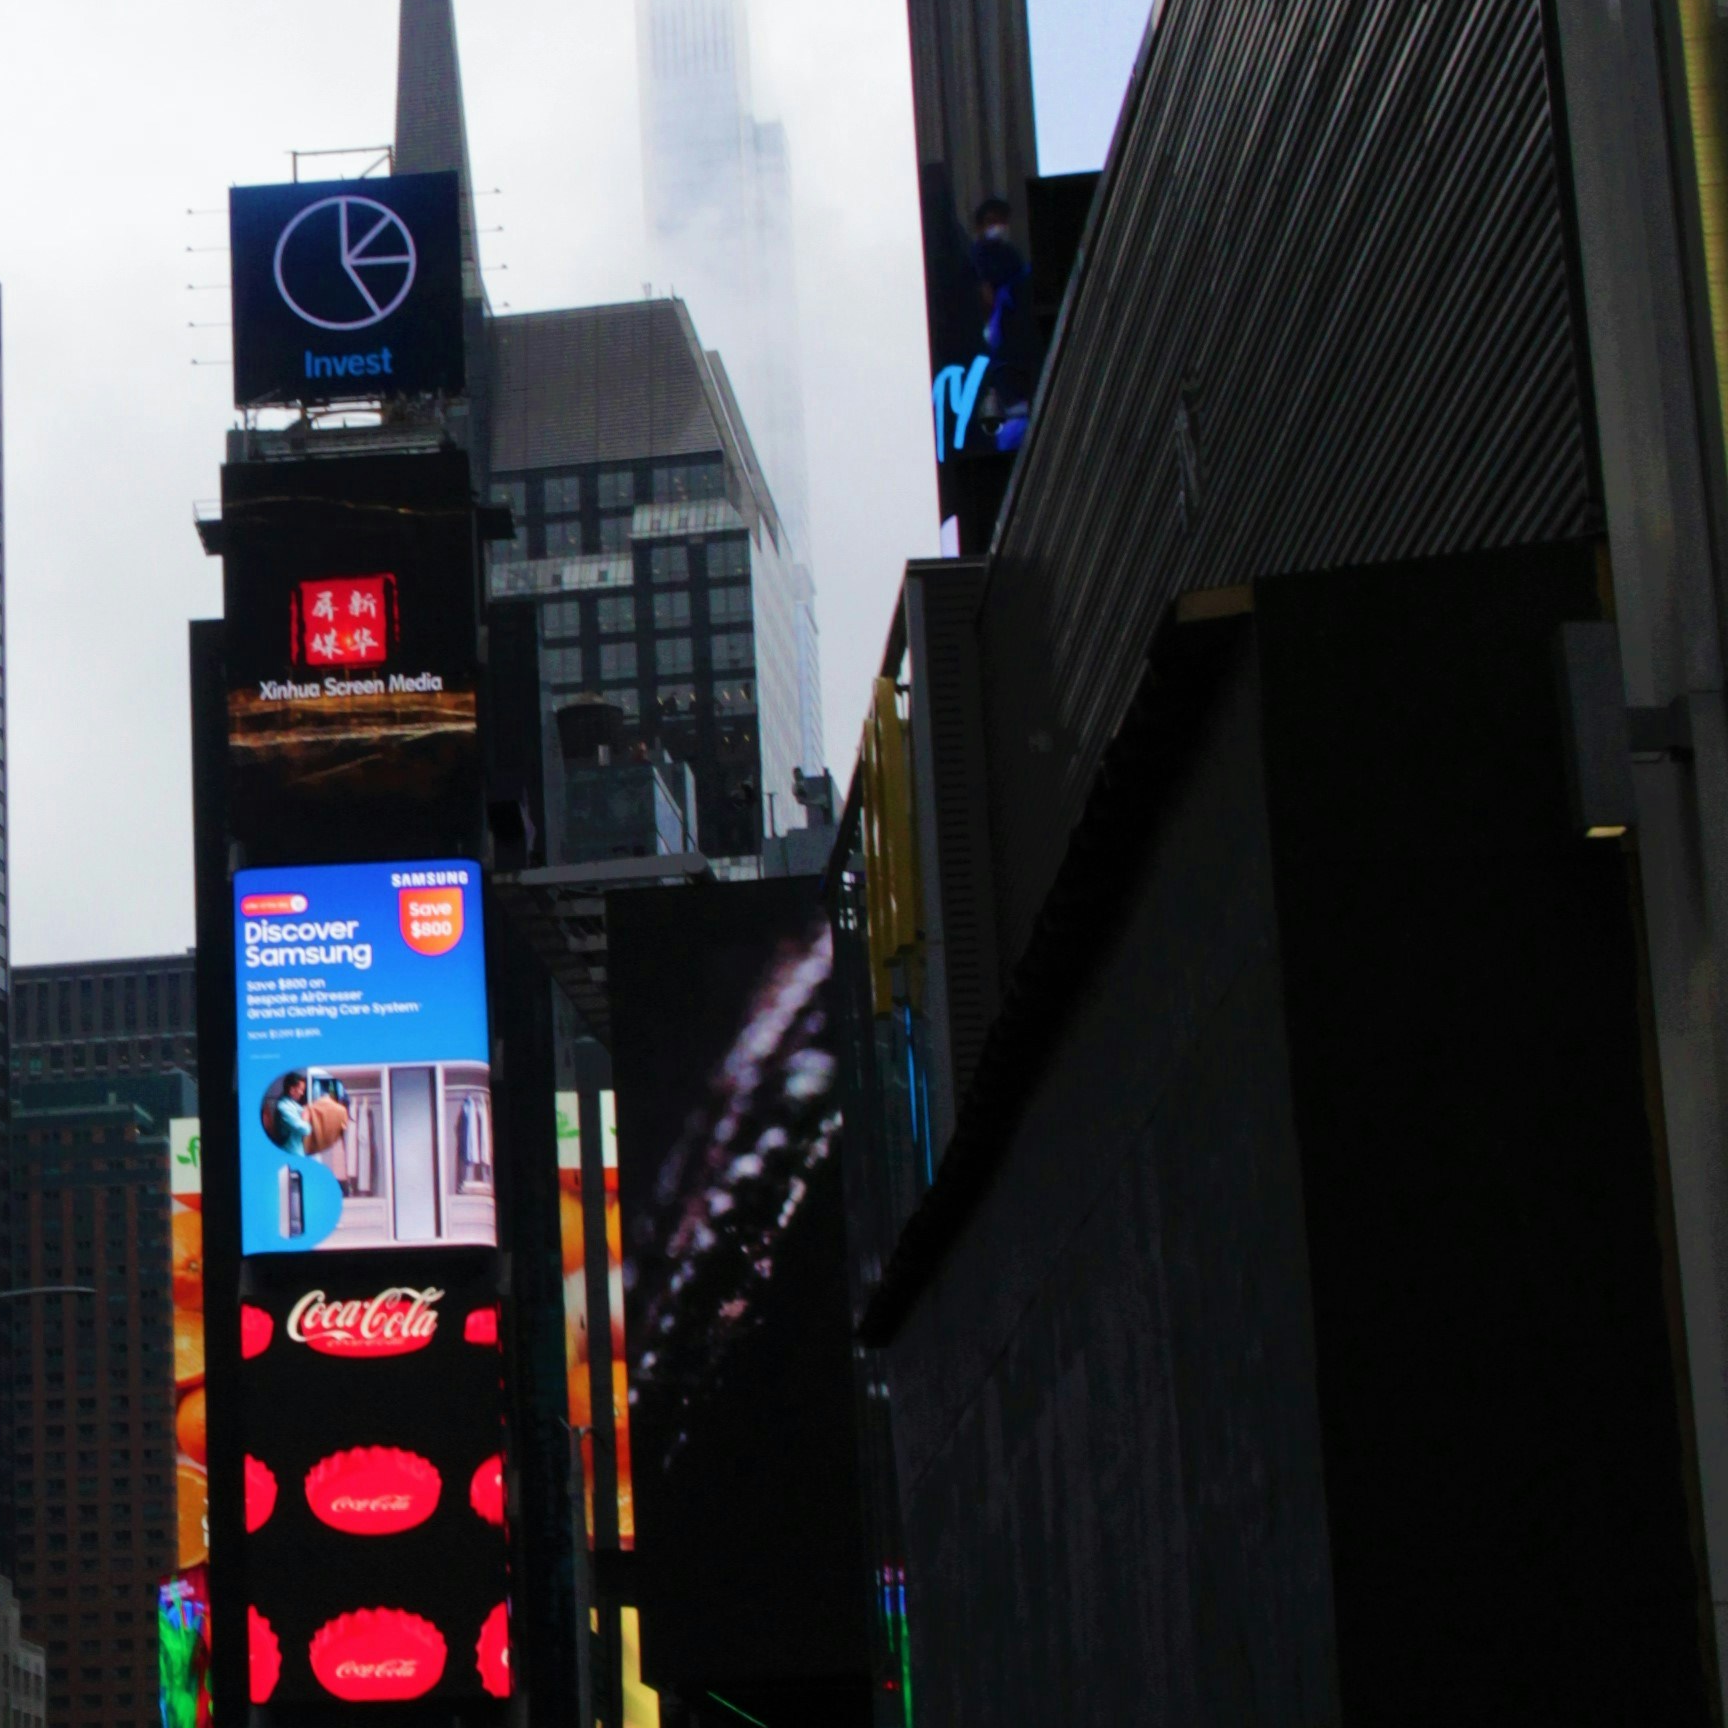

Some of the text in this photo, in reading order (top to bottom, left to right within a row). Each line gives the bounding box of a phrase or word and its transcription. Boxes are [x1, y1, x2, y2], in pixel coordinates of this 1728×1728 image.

[305, 349, 393, 378] Invest
[259, 672, 443, 700] Xinhua Screen Media
[391, 870, 469, 888] SAMSUNG
[408, 901, 452, 918] Save
[244, 919, 359, 944] Discover
[410, 920, 452, 940] $800
[245, 943, 373, 970] Samsung
[246, 980, 276, 992] Save
[309, 978, 326, 989] on
[246, 993, 298, 1007] Bespoke
[287, 1004, 338, 1019] Clothing
[339, 1003, 370, 1015] Care
[286, 1286, 445, 1343] Coca-Cola
